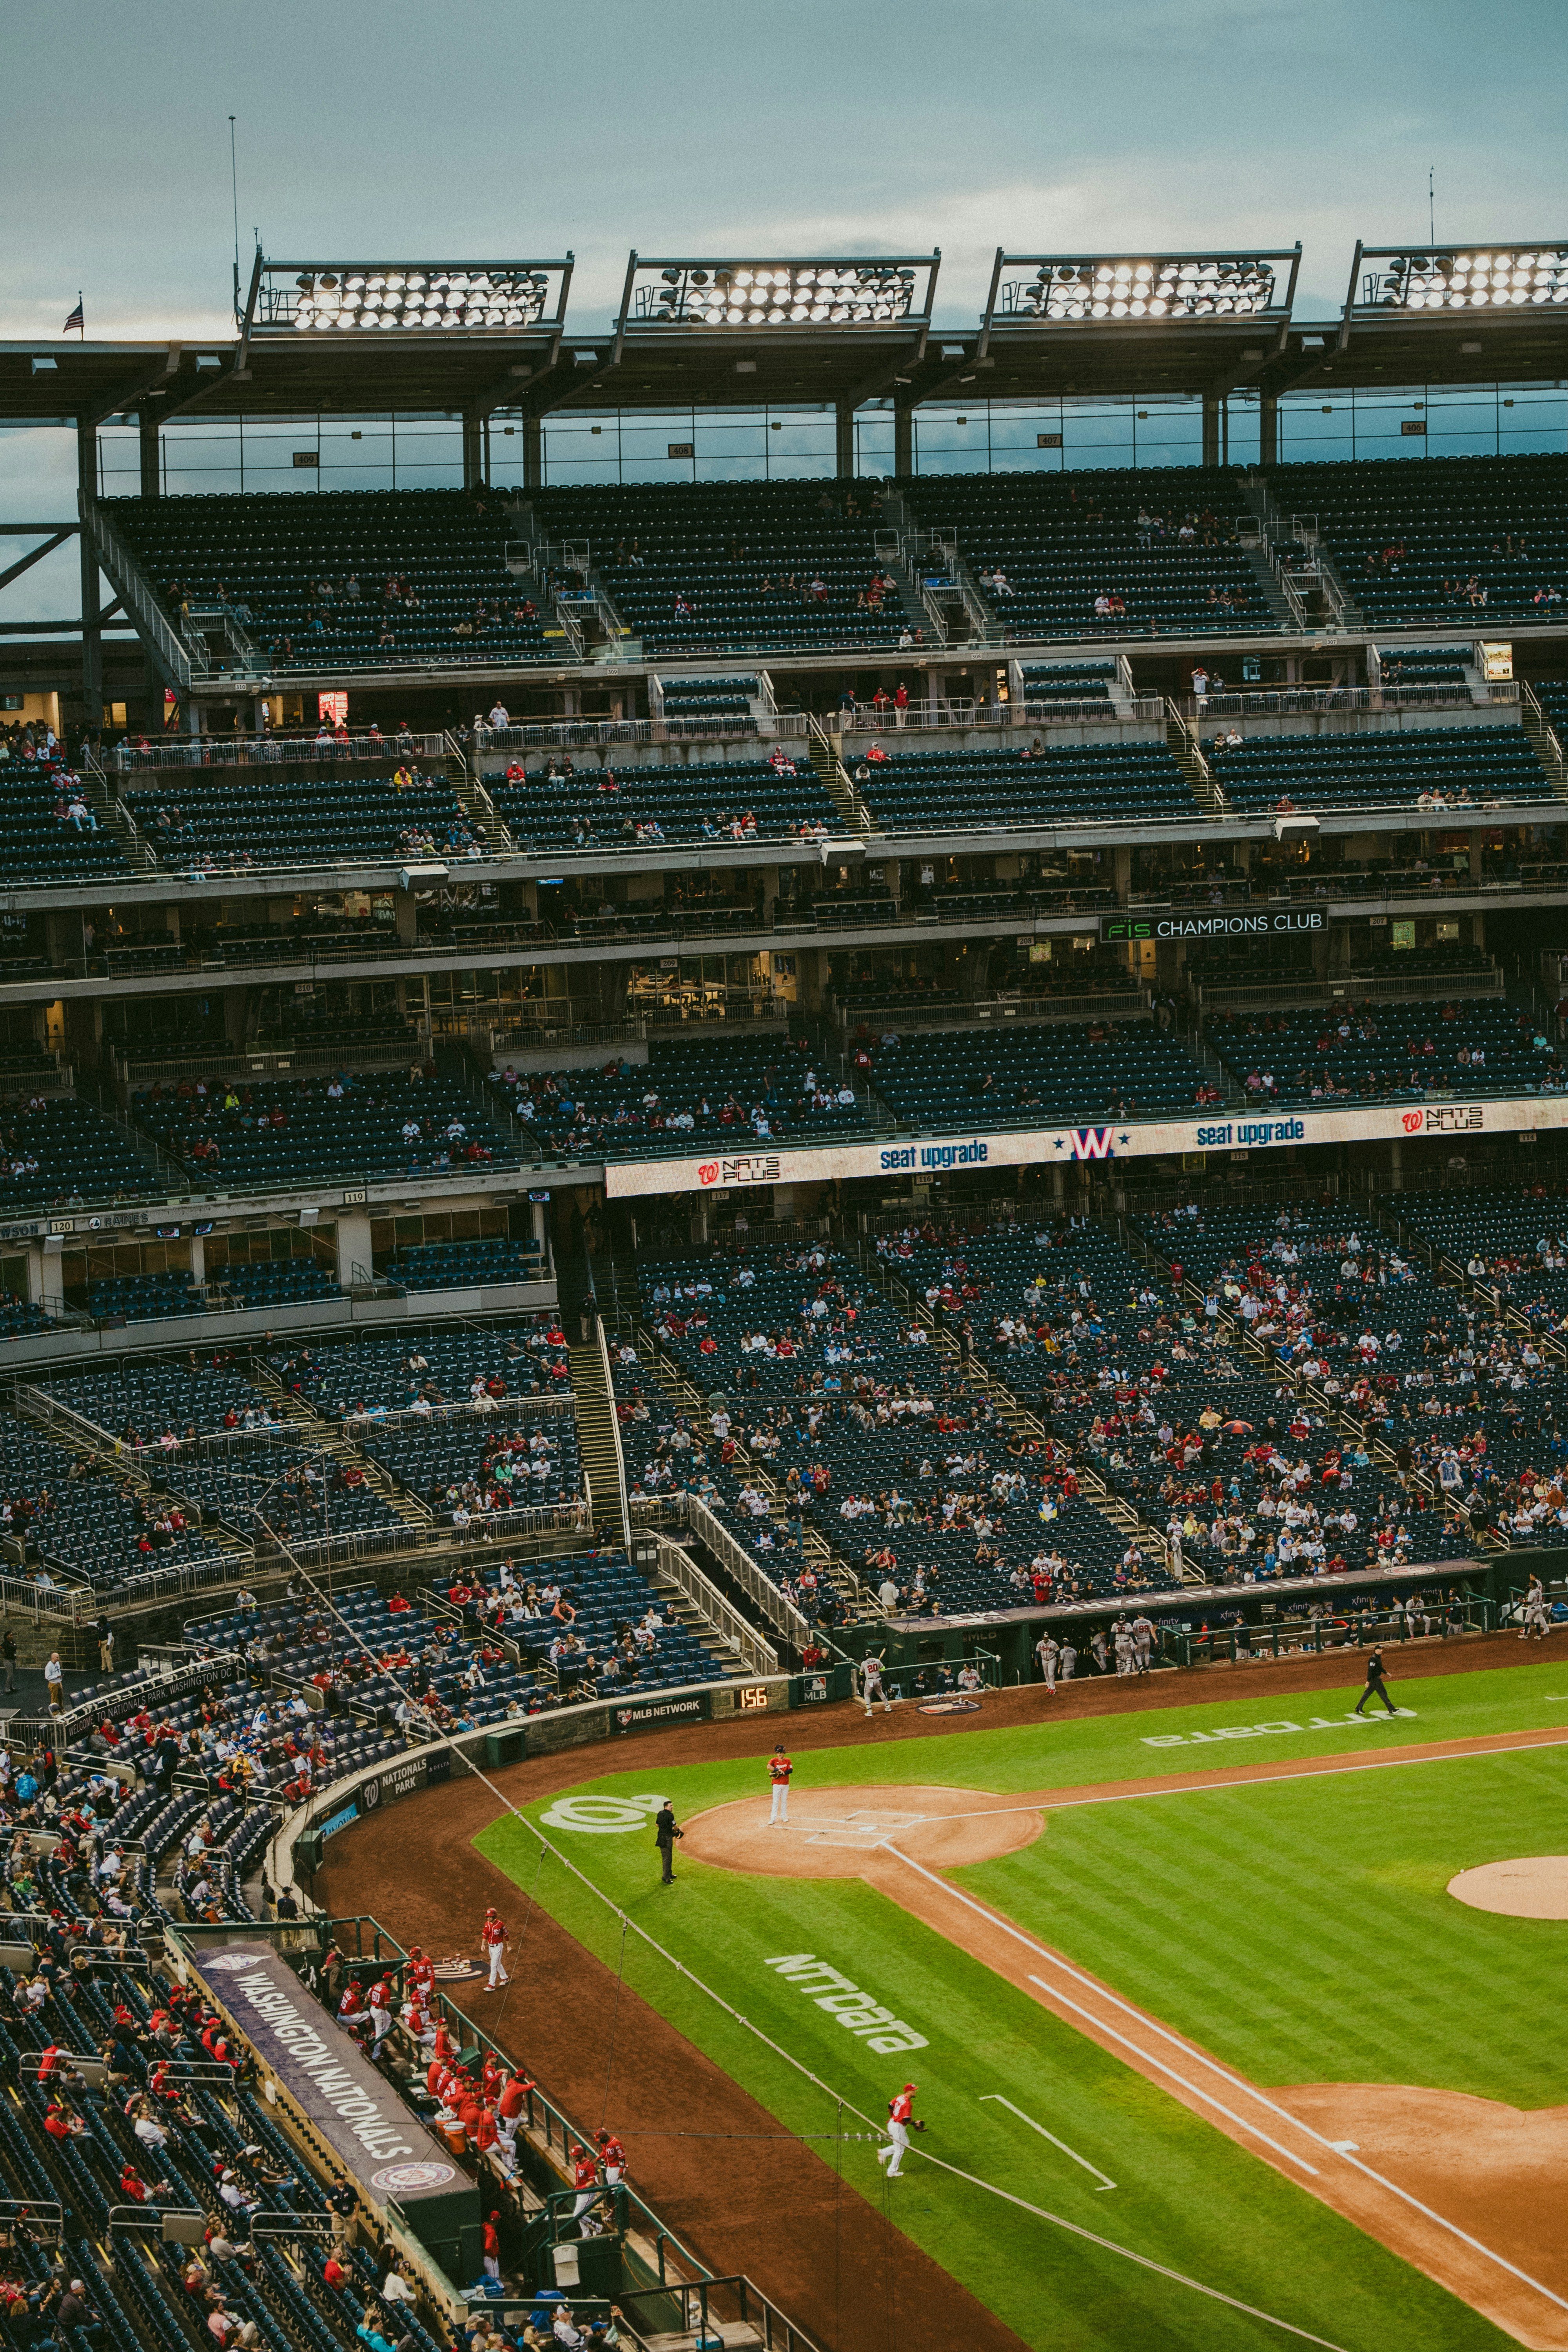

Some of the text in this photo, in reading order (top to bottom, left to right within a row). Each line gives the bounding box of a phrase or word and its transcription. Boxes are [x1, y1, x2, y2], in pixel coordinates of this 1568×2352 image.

[1157, 916, 1268, 936] CHAMPIONS
[1274, 914, 1322, 933] CLUB
[1427, 1107, 1483, 1120] NATS
[1197, 1117, 1304, 1145] seat upgrade
[1427, 1119, 1483, 1131] PLUS
[1070, 1127, 1114, 1159] W
[881, 1139, 988, 1169] seat upgrade
[723, 1157, 780, 1171] NATS
[724, 1168, 780, 1183] PLUS
[348, 1193, 363, 1202] 119
[54, 1222, 71, 1231] 120
[104, 1213, 149, 1227] RAINES
[1055, 1576, 1345, 1612] NATIONALS PARK
[1138, 1625, 1149, 1633] 99
[867, 1663, 878, 1673] 20
[68, 1668, 232, 1737] WELCOME TO NATIONALS PARK, WASHINGTON DC
[741, 1687, 767, 1708] 156
[804, 1691, 827, 1702] MLB
[632, 1700, 699, 1720] MLB NETWORK
[382, 1758, 427, 1788] NATIONALS
[434, 1761, 450, 1770] DELTA
[395, 1777, 416, 1794] PARK
[372, 1991, 380, 2004] 60
[232, 1972, 413, 2160] WASHINGTON NATIONALS
